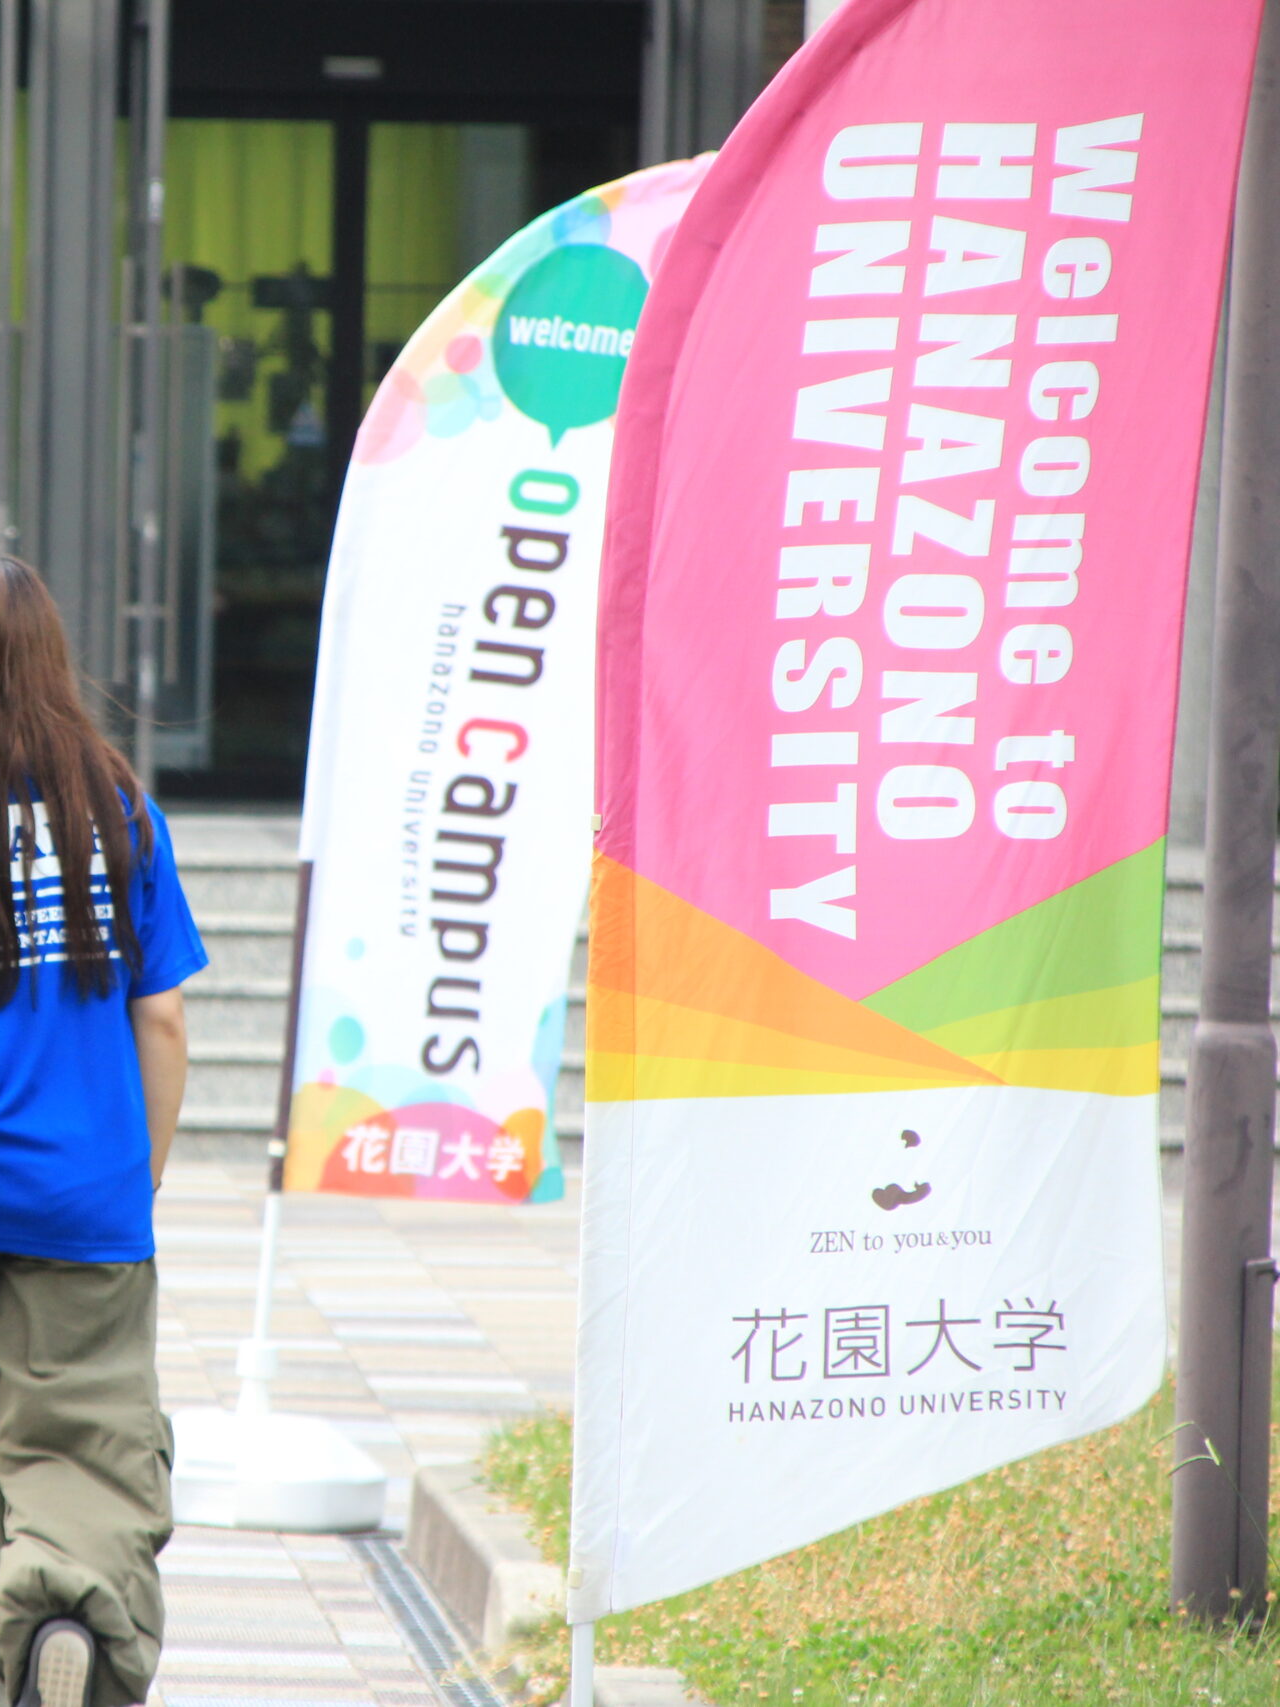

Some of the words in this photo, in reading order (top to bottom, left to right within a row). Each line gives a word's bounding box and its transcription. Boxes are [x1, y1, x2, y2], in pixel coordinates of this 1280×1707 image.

[509, 315, 635, 359] welcome
[1000, 112, 1145, 686] Welcome
[767, 122, 924, 941] UNIVERSITY
[876, 122, 1038, 841] HANAZONO
[418, 603, 468, 754] hanazono
[993, 728, 1076, 841] to
[399, 770, 431, 938] university
[341, 1124, 526, 1182] 花園大学
[810, 1230, 856, 1254] ZEN
[863, 1232, 884, 1251] to
[731, 1297, 1067, 1384] 花園大学
[729, 1396, 886, 1422] HANAZONO
[899, 1389, 1068, 1415] UNIVERSITY
